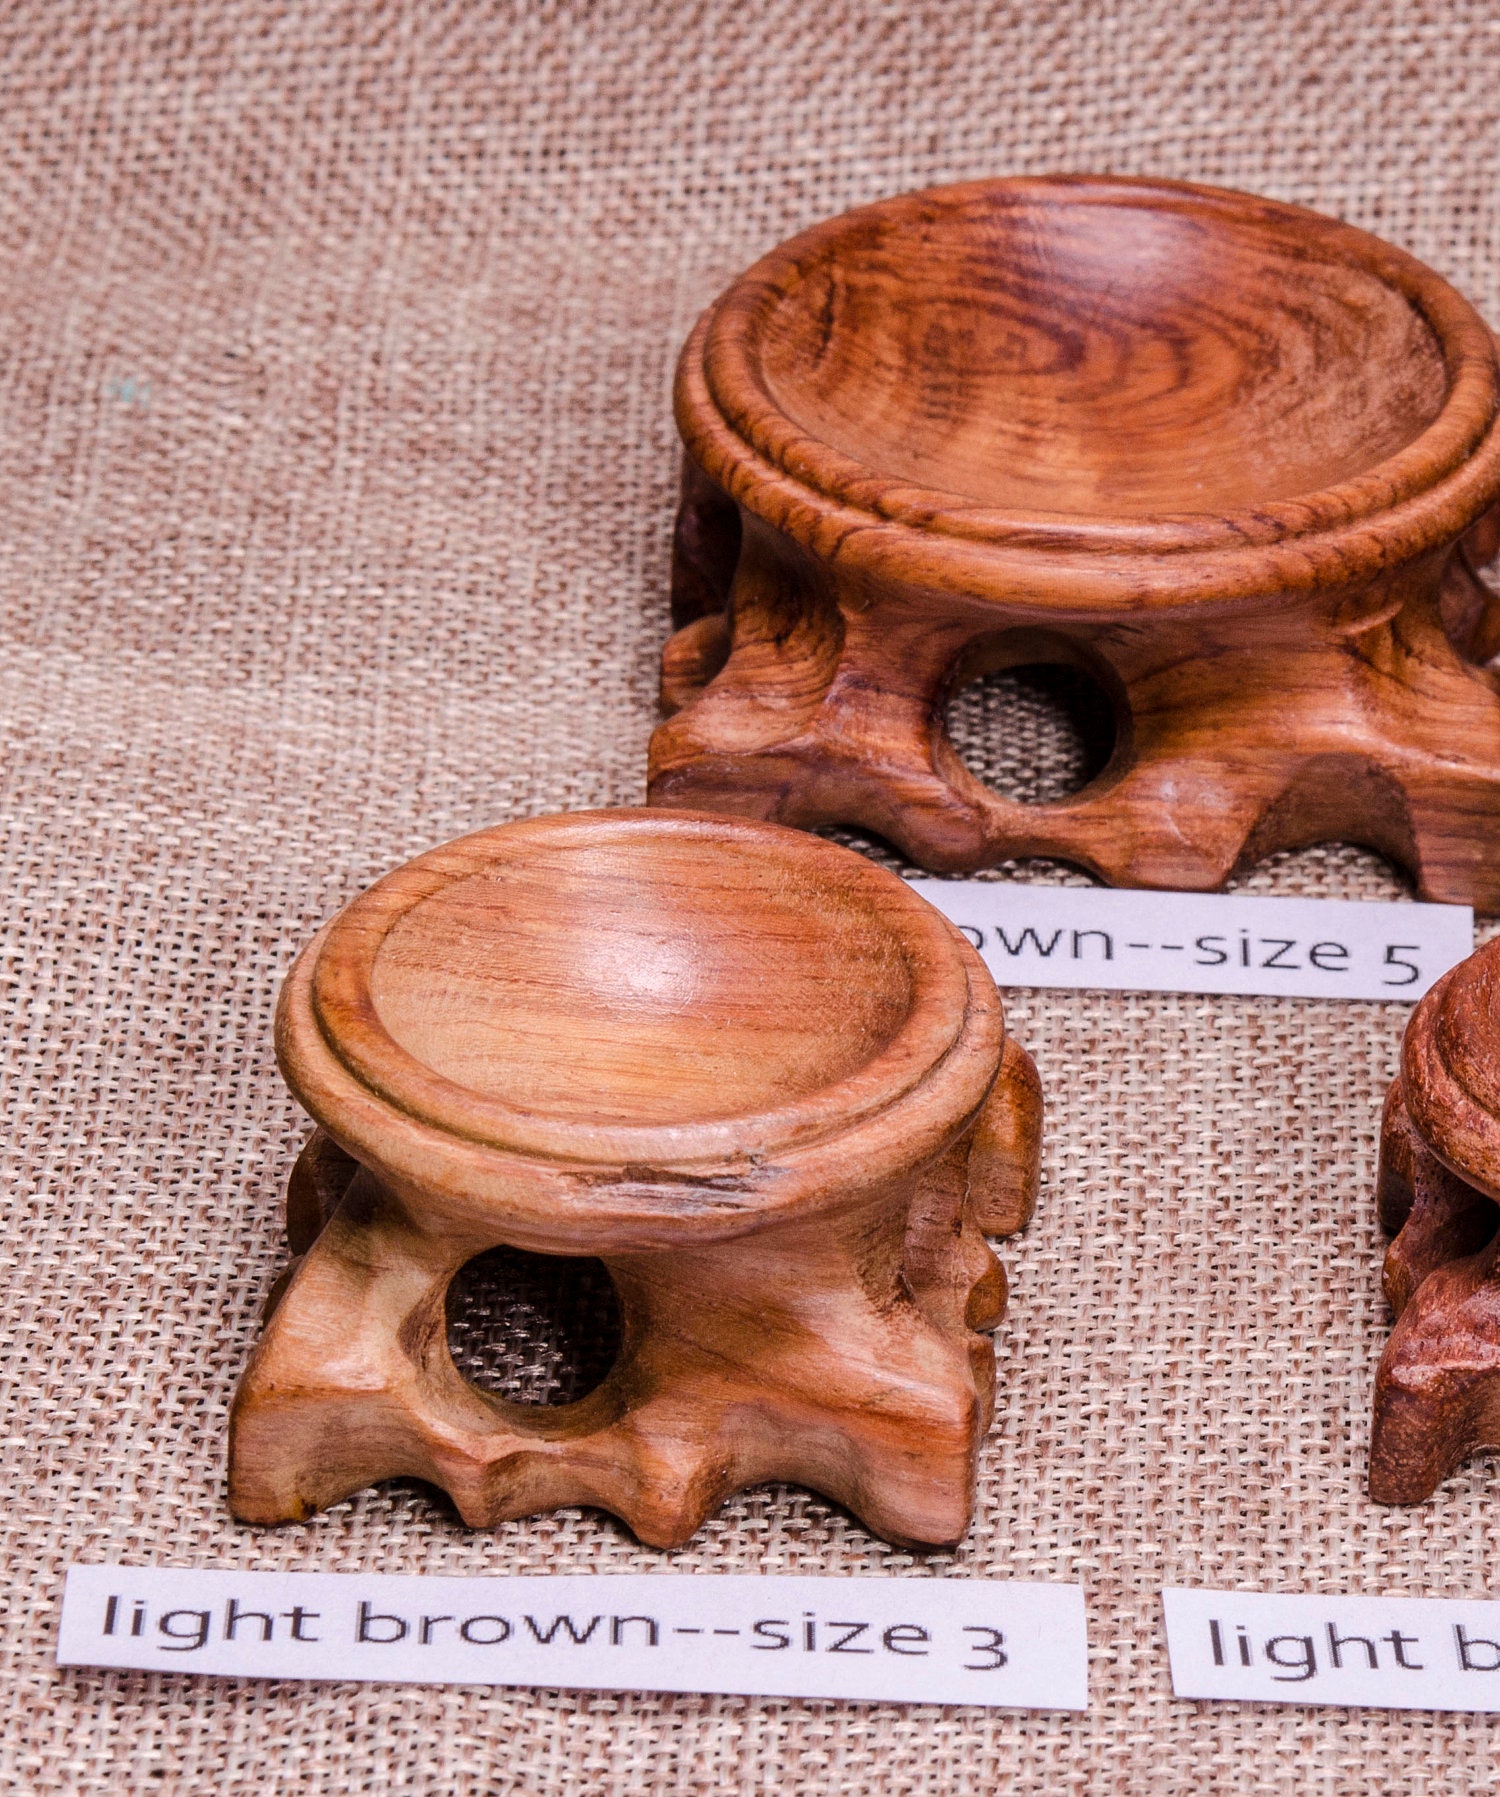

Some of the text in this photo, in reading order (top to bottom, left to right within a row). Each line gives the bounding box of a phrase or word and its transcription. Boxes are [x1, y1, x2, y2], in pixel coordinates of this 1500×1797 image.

[1382, 945, 1422, 986] 5
[102, 1594, 1009, 1672] light brown--size 3
[1207, 1618, 1424, 1682] light
